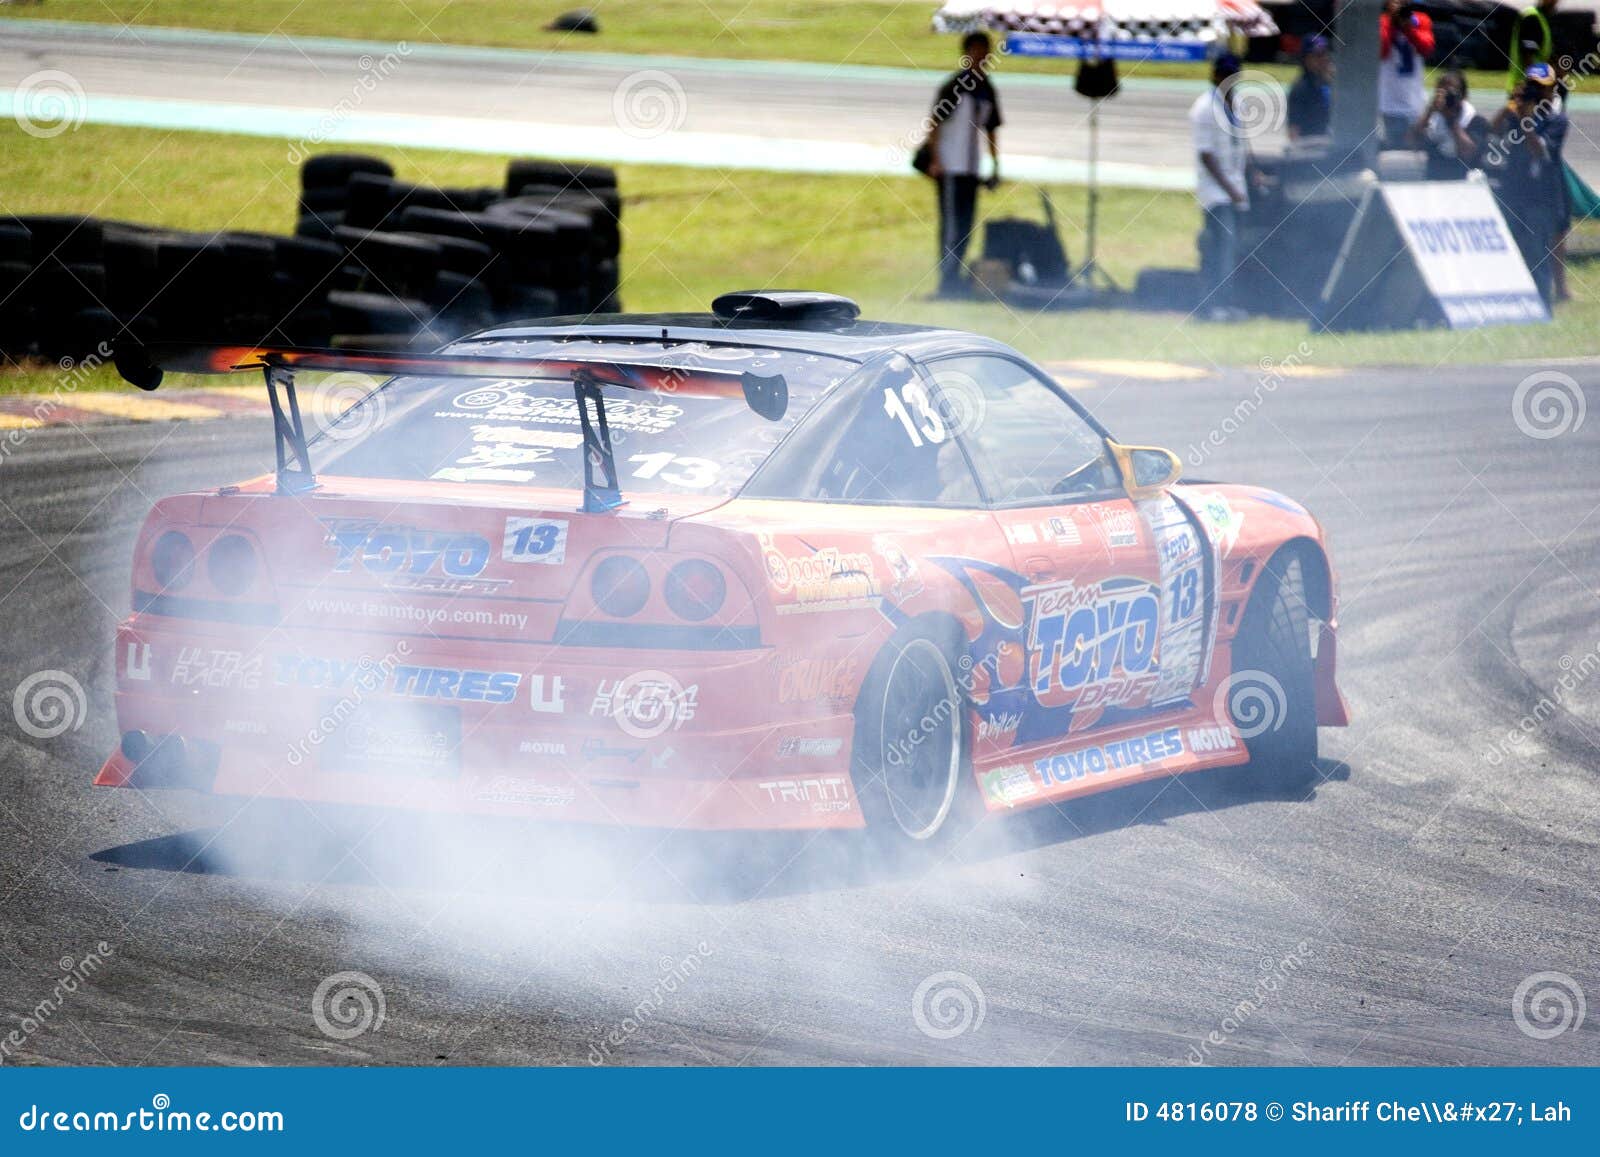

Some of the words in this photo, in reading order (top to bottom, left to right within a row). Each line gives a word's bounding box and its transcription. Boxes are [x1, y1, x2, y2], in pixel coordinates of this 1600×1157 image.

[884, 382, 946, 447] 13
[625, 452, 721, 488] 13
[322, 527, 491, 578] TOYO
[511, 525, 560, 555] 13
[1020, 578, 1102, 650] Team
[1169, 567, 1198, 624] 13
[176, 648, 264, 671] ULTRA
[1032, 592, 1161, 694] TOYO
[171, 665, 261, 689] RACING
[388, 665, 522, 704] TIRES
[596, 679, 699, 703] ULTRA
[519, 740, 567, 755] MOTUL
[1034, 746, 1106, 787] TOYO
[1103, 726, 1185, 775] TIRES
[1187, 725, 1237, 752] MOTUL
